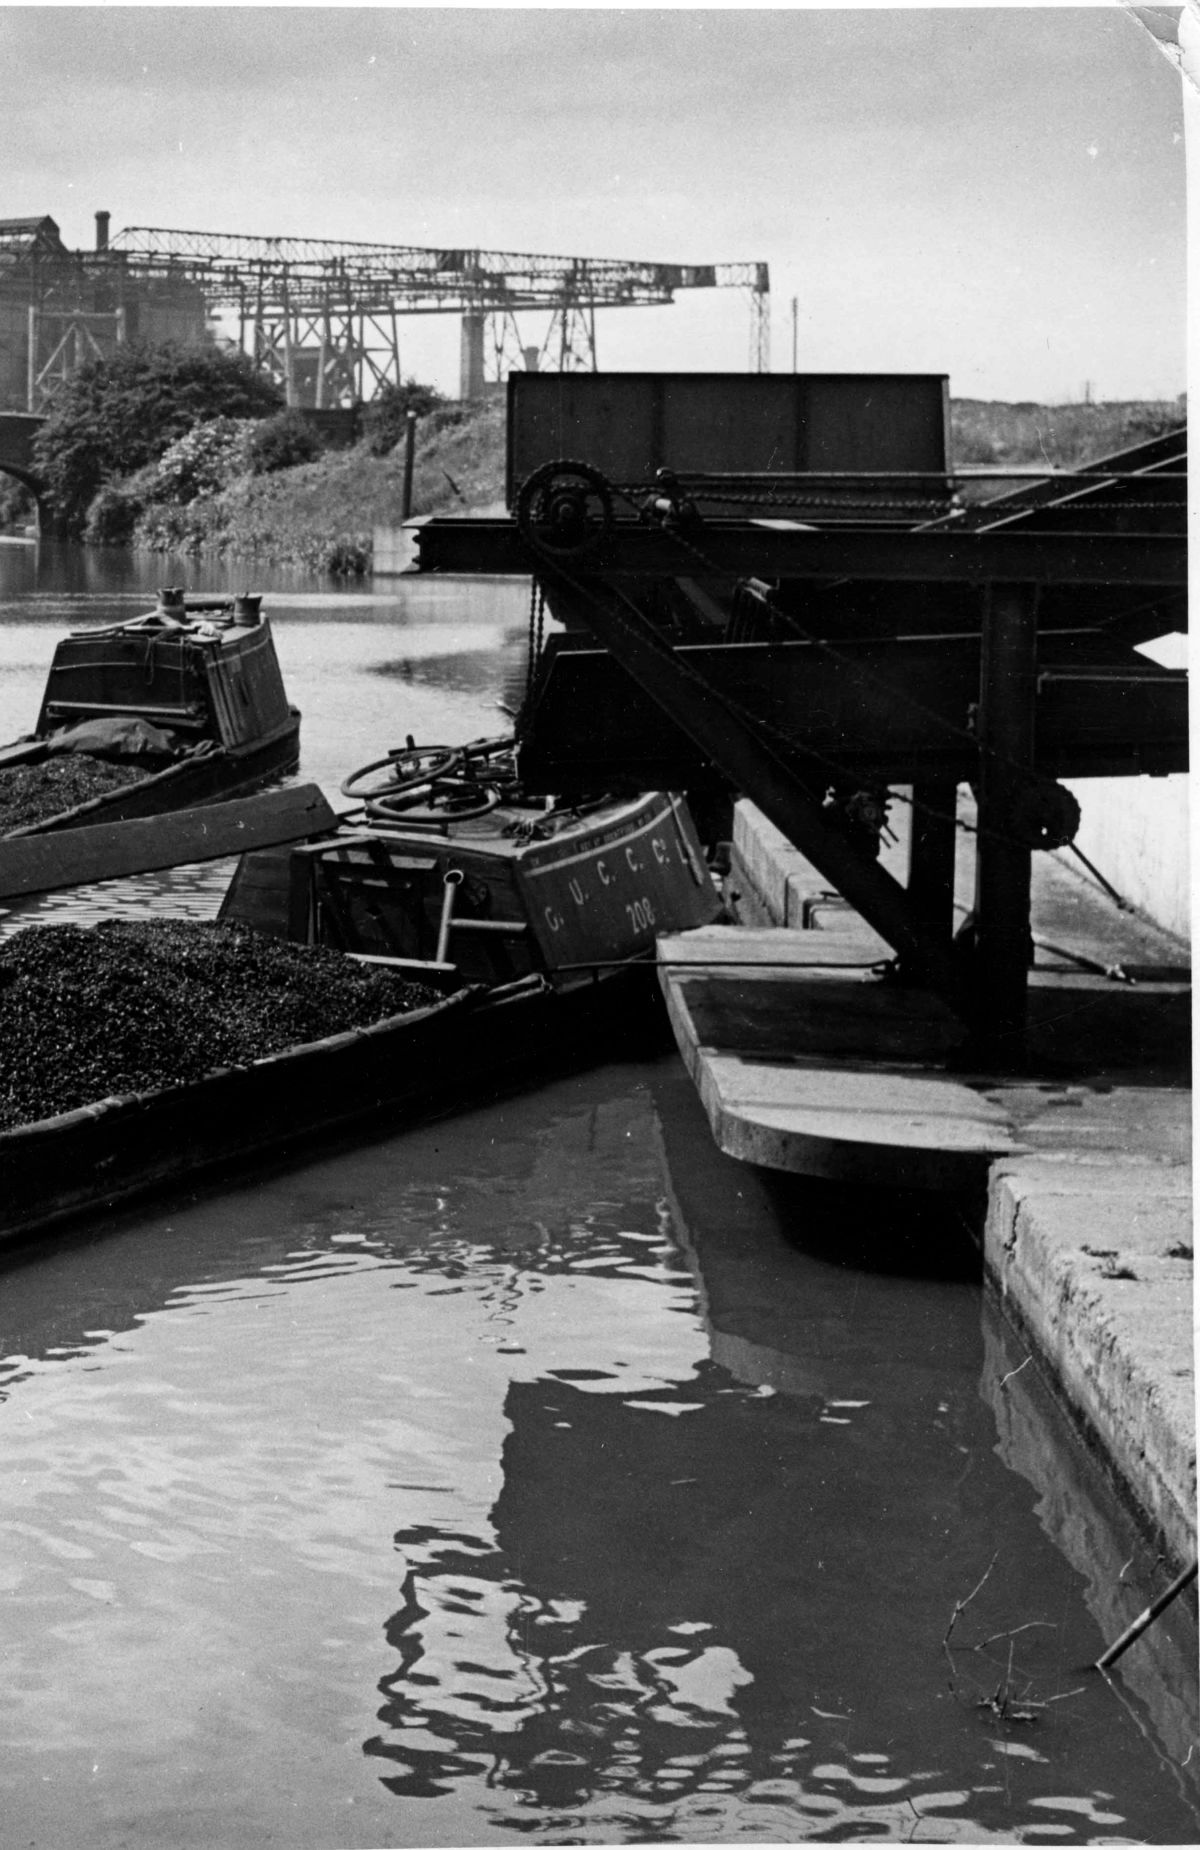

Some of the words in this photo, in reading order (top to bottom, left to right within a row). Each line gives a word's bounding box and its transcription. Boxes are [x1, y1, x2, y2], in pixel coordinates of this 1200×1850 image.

[569, 877, 589, 905] U.
[597, 860, 616, 886] C.
[625, 847, 644, 872] C.
[626, 897, 656, 935] 208
